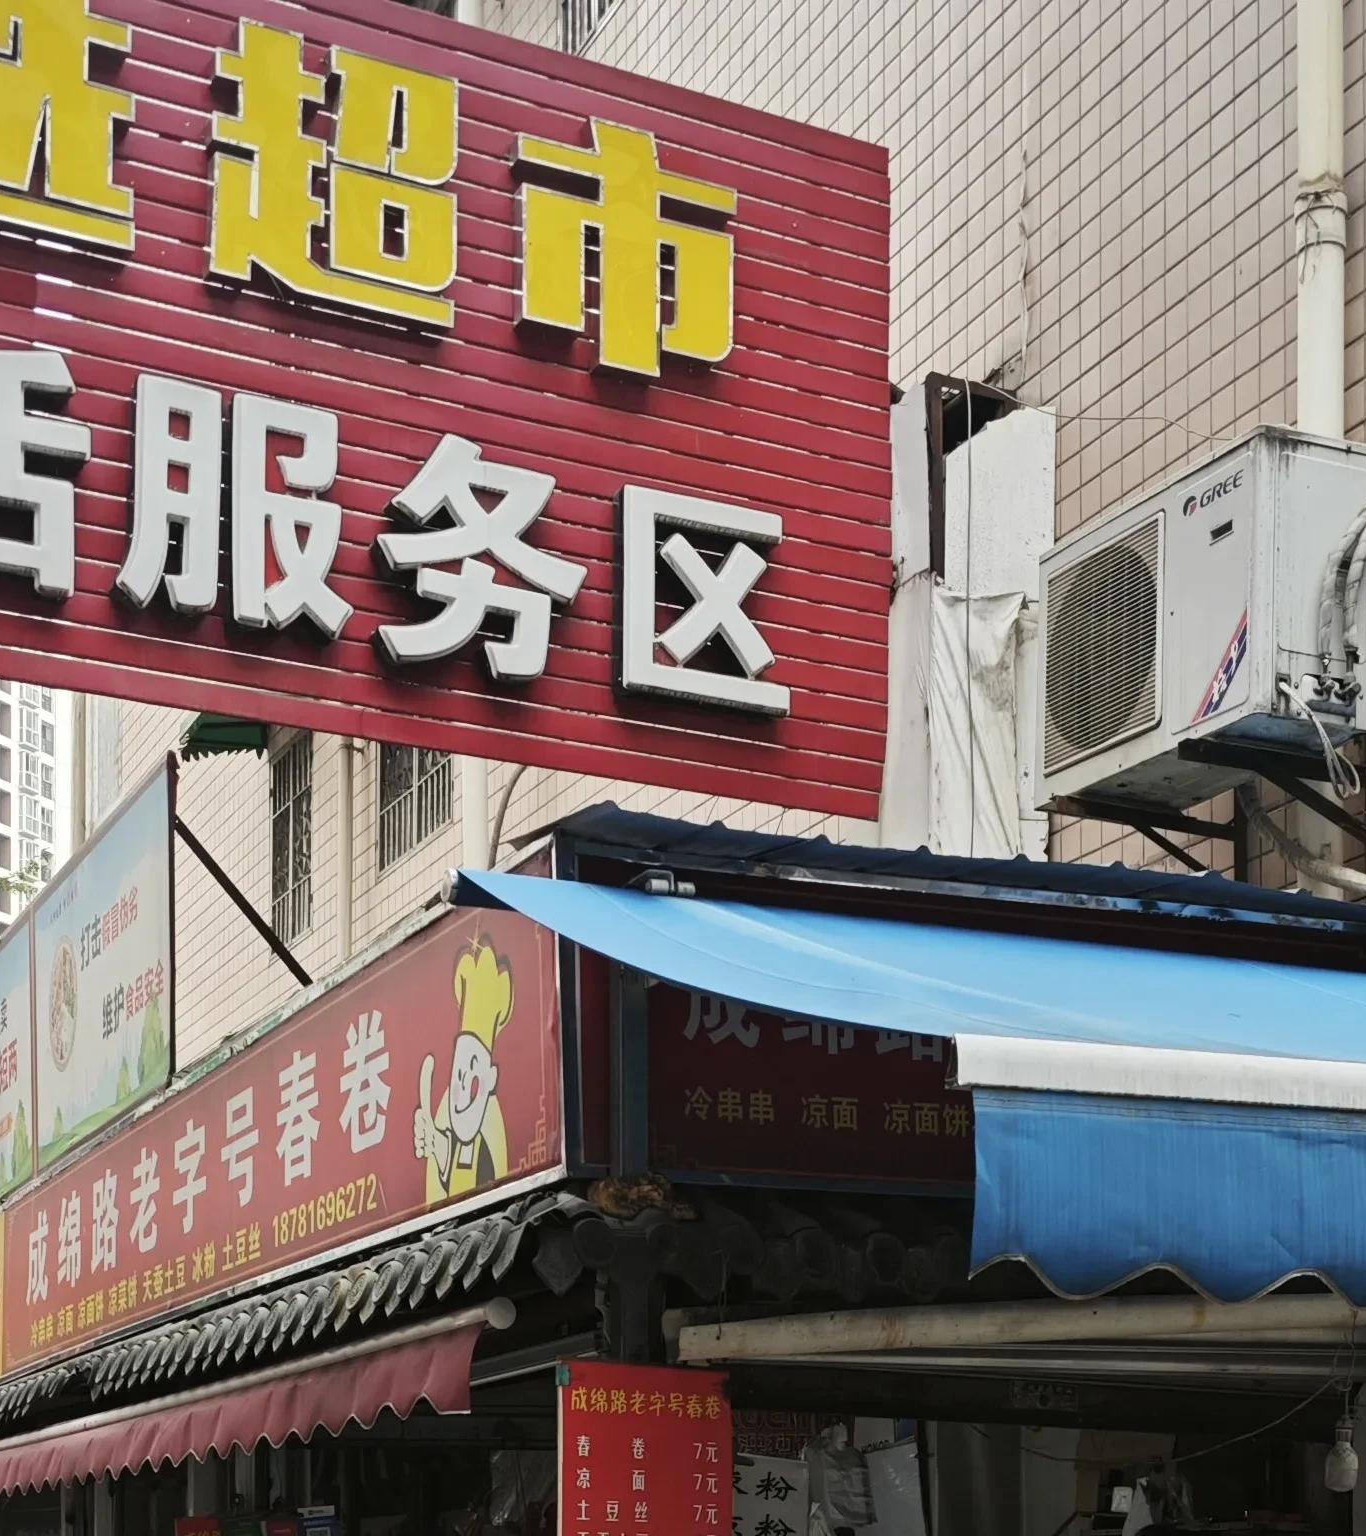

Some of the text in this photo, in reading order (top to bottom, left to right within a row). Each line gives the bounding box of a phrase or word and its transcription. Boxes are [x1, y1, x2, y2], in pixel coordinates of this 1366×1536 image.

[1198, 468, 1244, 510] GREE
[79, 886, 139, 973] 打击假冒伪劣
[101, 957, 165, 1041] 维护食品安全
[684, 1085, 776, 1127] 冷串串
[800, 1093, 860, 1132] 凉面
[25, 1008, 393, 1306] 成绵路老字号春卷
[191, 1241, 216, 1284] 冰粉
[221, 1223, 263, 1274] 土豆丝
[271, 1172, 380, 1251] 18781696272
[571, 1388, 720, 1421] 成绵路老字号春卷
[576, 1435, 719, 1463] 春 卷 7元
[576, 1468, 719, 1494] 凉 面 7元
[576, 1501, 719, 1525] 土 豆 丝 7元
